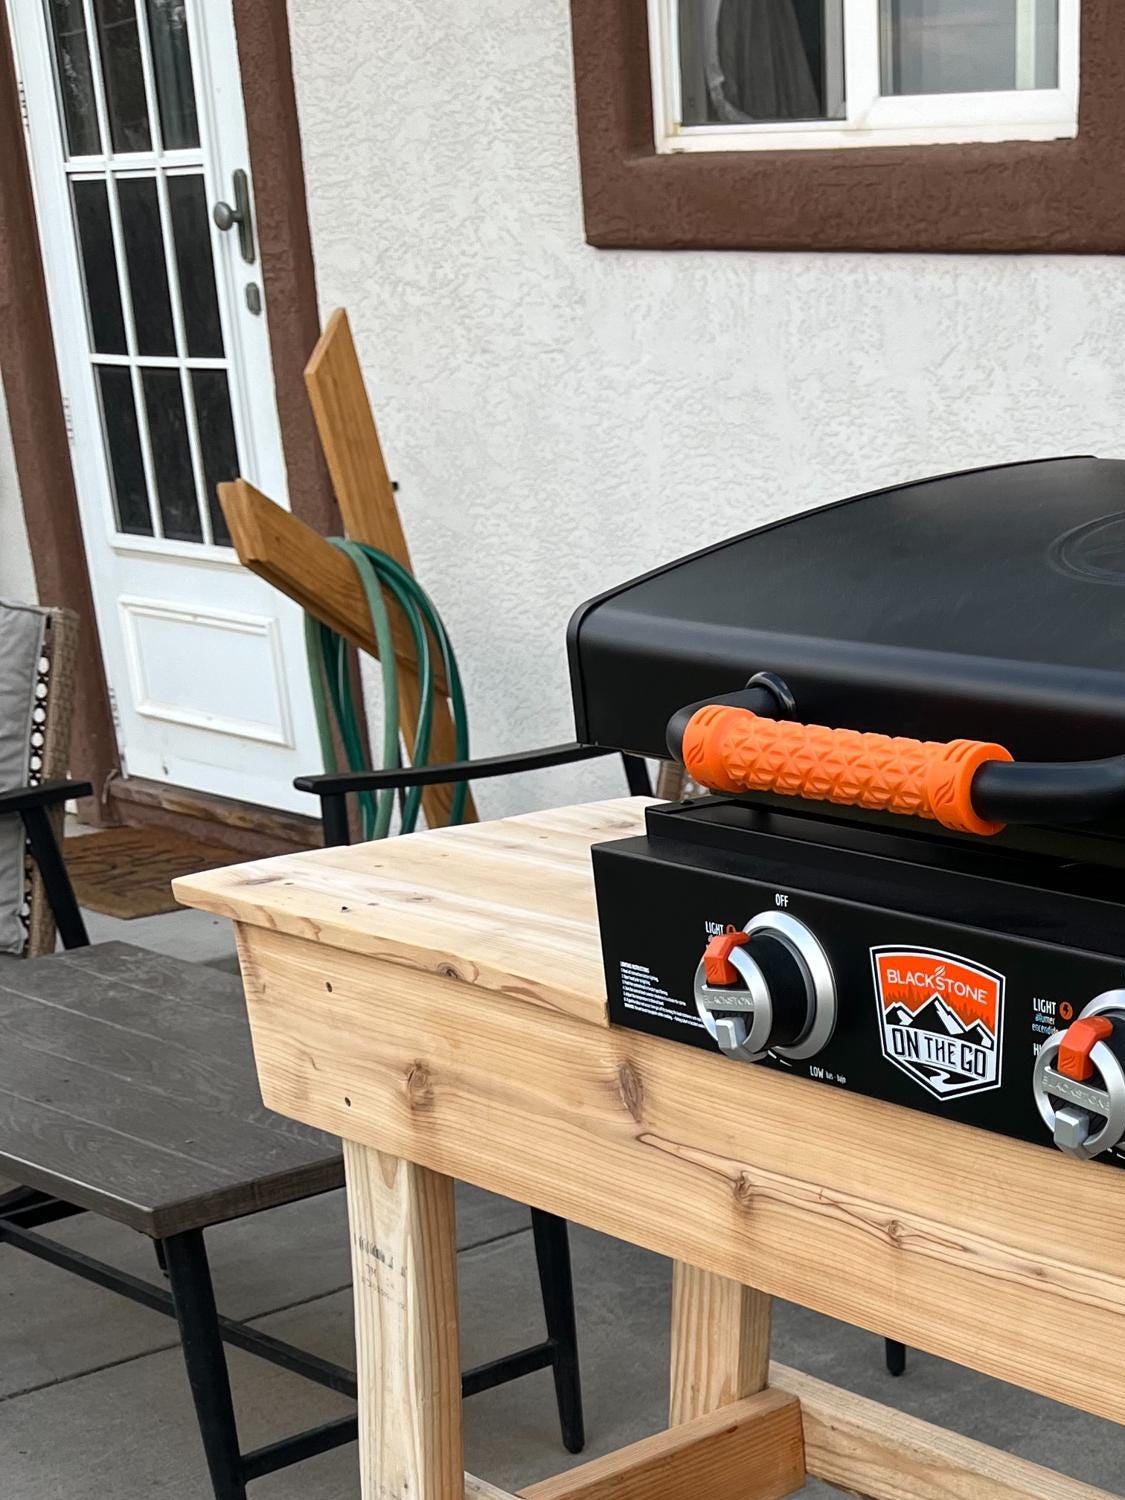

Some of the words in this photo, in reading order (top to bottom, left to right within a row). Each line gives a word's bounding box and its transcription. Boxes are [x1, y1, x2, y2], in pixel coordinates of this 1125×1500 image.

[775, 893, 789, 907] OFF
[705, 920, 724, 936] LIGHT
[886, 968, 988, 1005] BLACKSTONE
[1033, 997, 1056, 1015] LIGHT
[892, 1028, 921, 1060] ON
[924, 1036, 957, 1066] THE
[960, 1043, 987, 1078] GO
[809, 1065, 824, 1079] LOW
